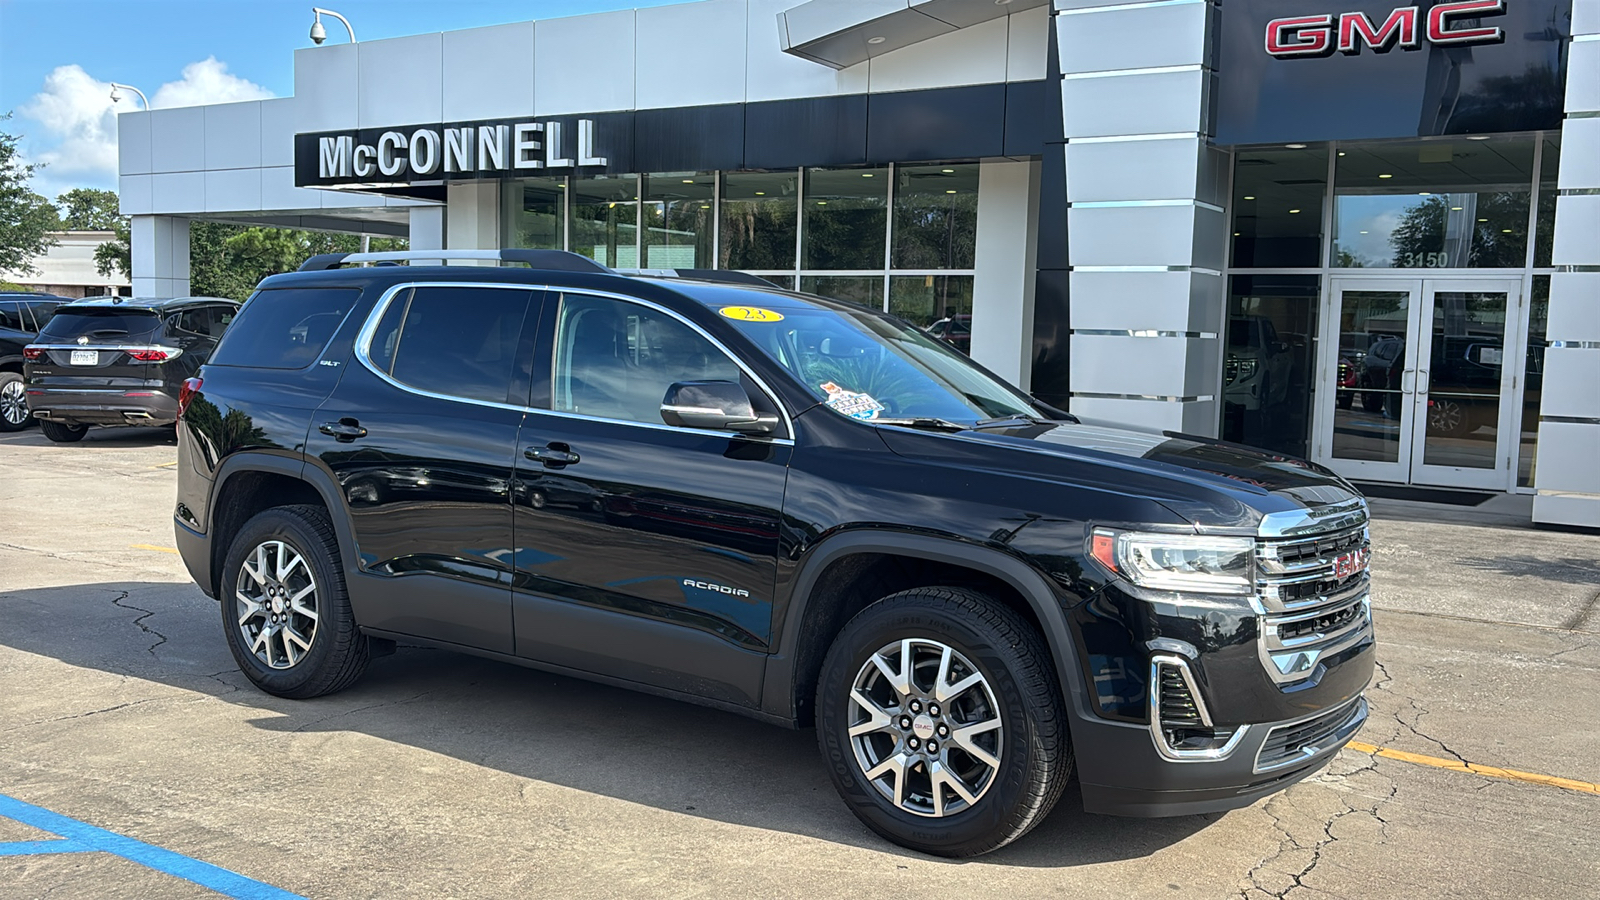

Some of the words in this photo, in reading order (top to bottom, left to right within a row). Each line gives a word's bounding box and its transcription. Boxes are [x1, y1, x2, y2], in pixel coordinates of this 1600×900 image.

[1265, 0, 1504, 56] GMC
[319, 119, 607, 178] McCONNELL
[1403, 252, 1448, 268] 3150
[738, 307, 766, 320] 23
[683, 579, 750, 598] ACADIA
[914, 723, 933, 731] GMC
